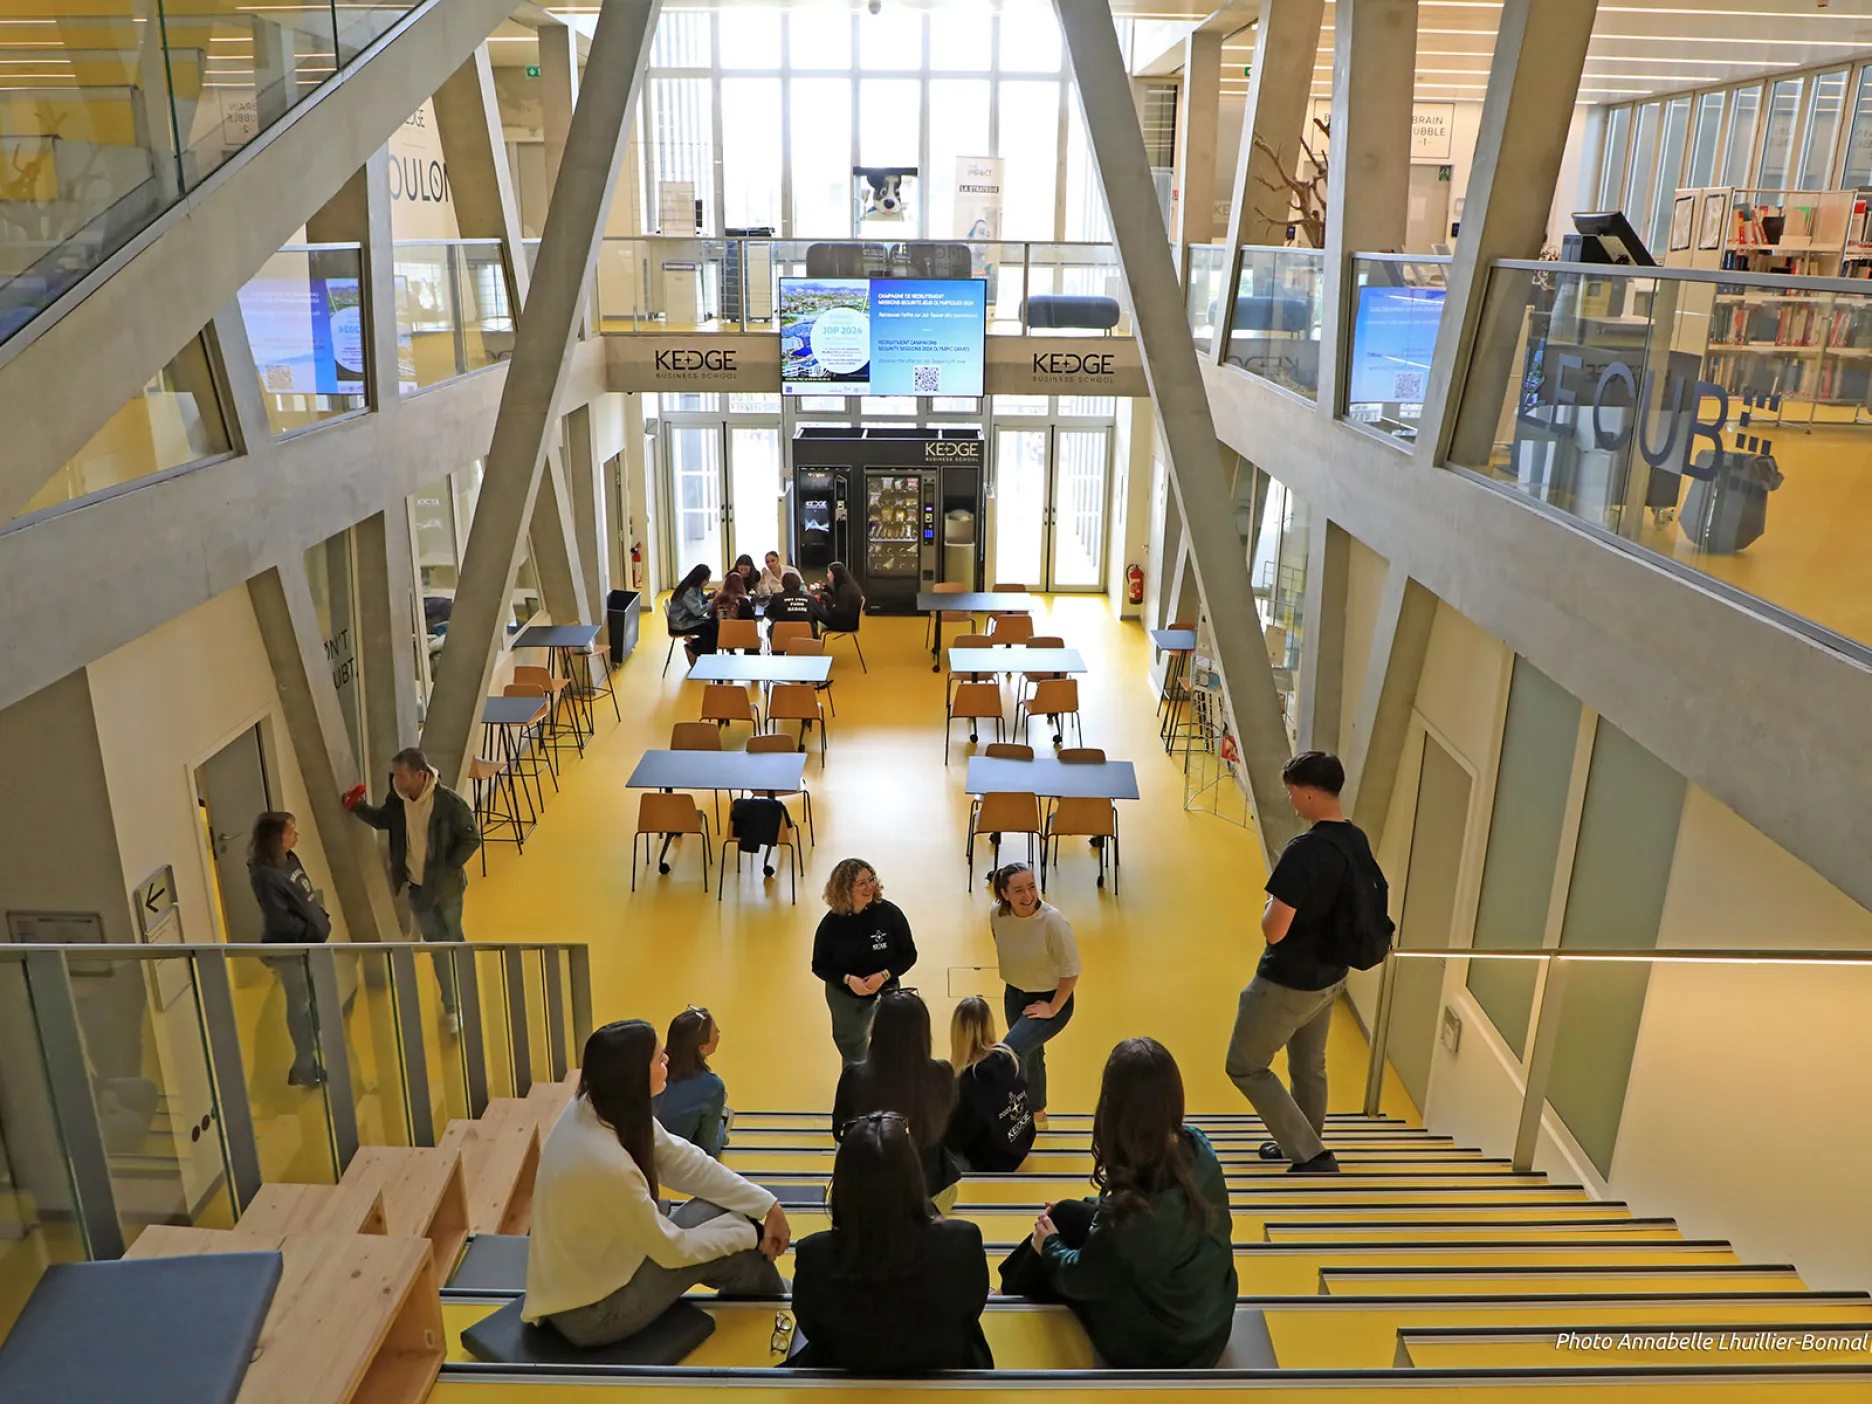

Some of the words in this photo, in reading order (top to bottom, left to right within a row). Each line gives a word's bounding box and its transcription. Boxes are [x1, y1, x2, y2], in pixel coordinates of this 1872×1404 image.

[1413, 126, 1446, 137] UBBLE
[823, 326, 840, 335] JOP
[841, 326, 863, 335] 2024
[655, 350, 737, 371] KEDGE
[1033, 353, 1115, 375] KEDGE
[925, 442, 979, 457] KEDGE
